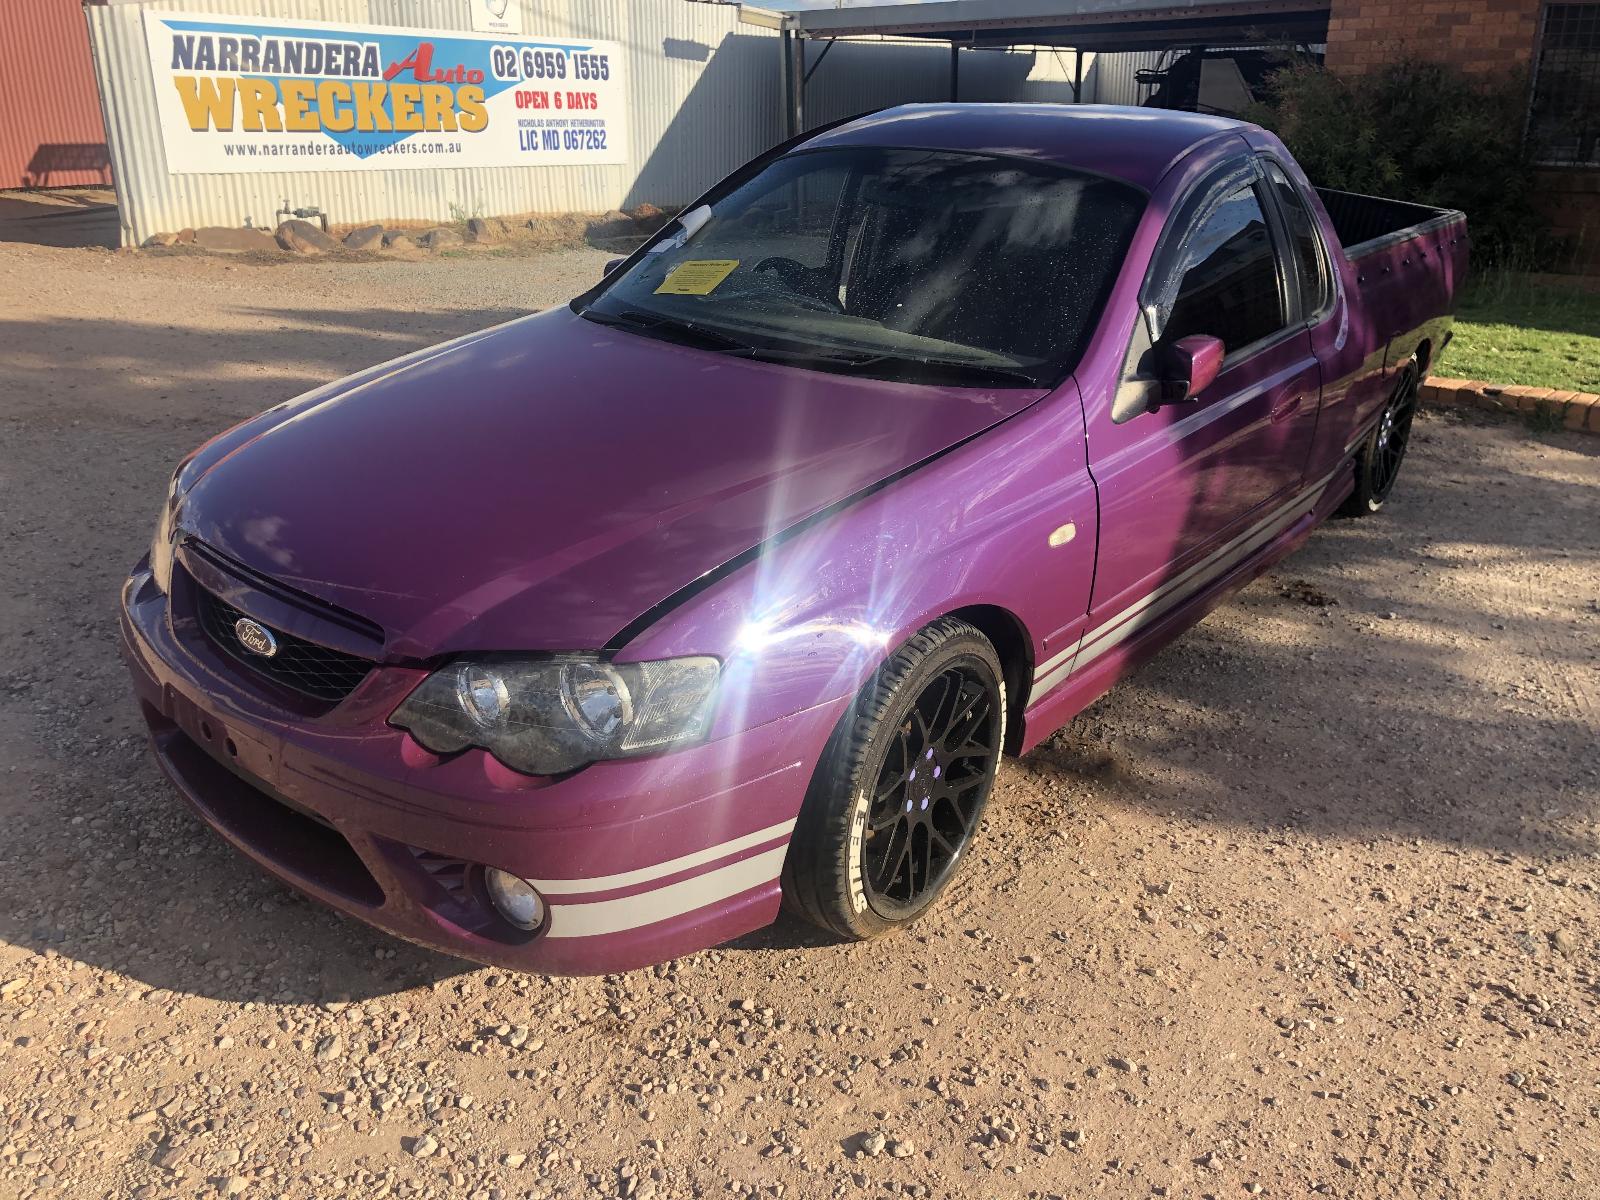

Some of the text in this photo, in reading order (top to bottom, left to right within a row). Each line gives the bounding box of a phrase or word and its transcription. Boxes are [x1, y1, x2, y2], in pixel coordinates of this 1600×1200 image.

[171, 35, 485, 84] NARRANDERA Auto
[493, 48, 610, 81] 02 6959 1555
[173, 76, 489, 133] WRECKERS
[515, 90, 598, 110] OPEN 6 DAYS
[518, 118, 545, 128] NICHOLAS
[546, 119, 569, 128] ANTHONY
[224, 141, 462, 156] www.narranderaautowreckers.com.au
[519, 129, 608, 151] LIC MD 067262
[242, 624, 267, 651] Ford
[848, 789, 869, 914] STREET
